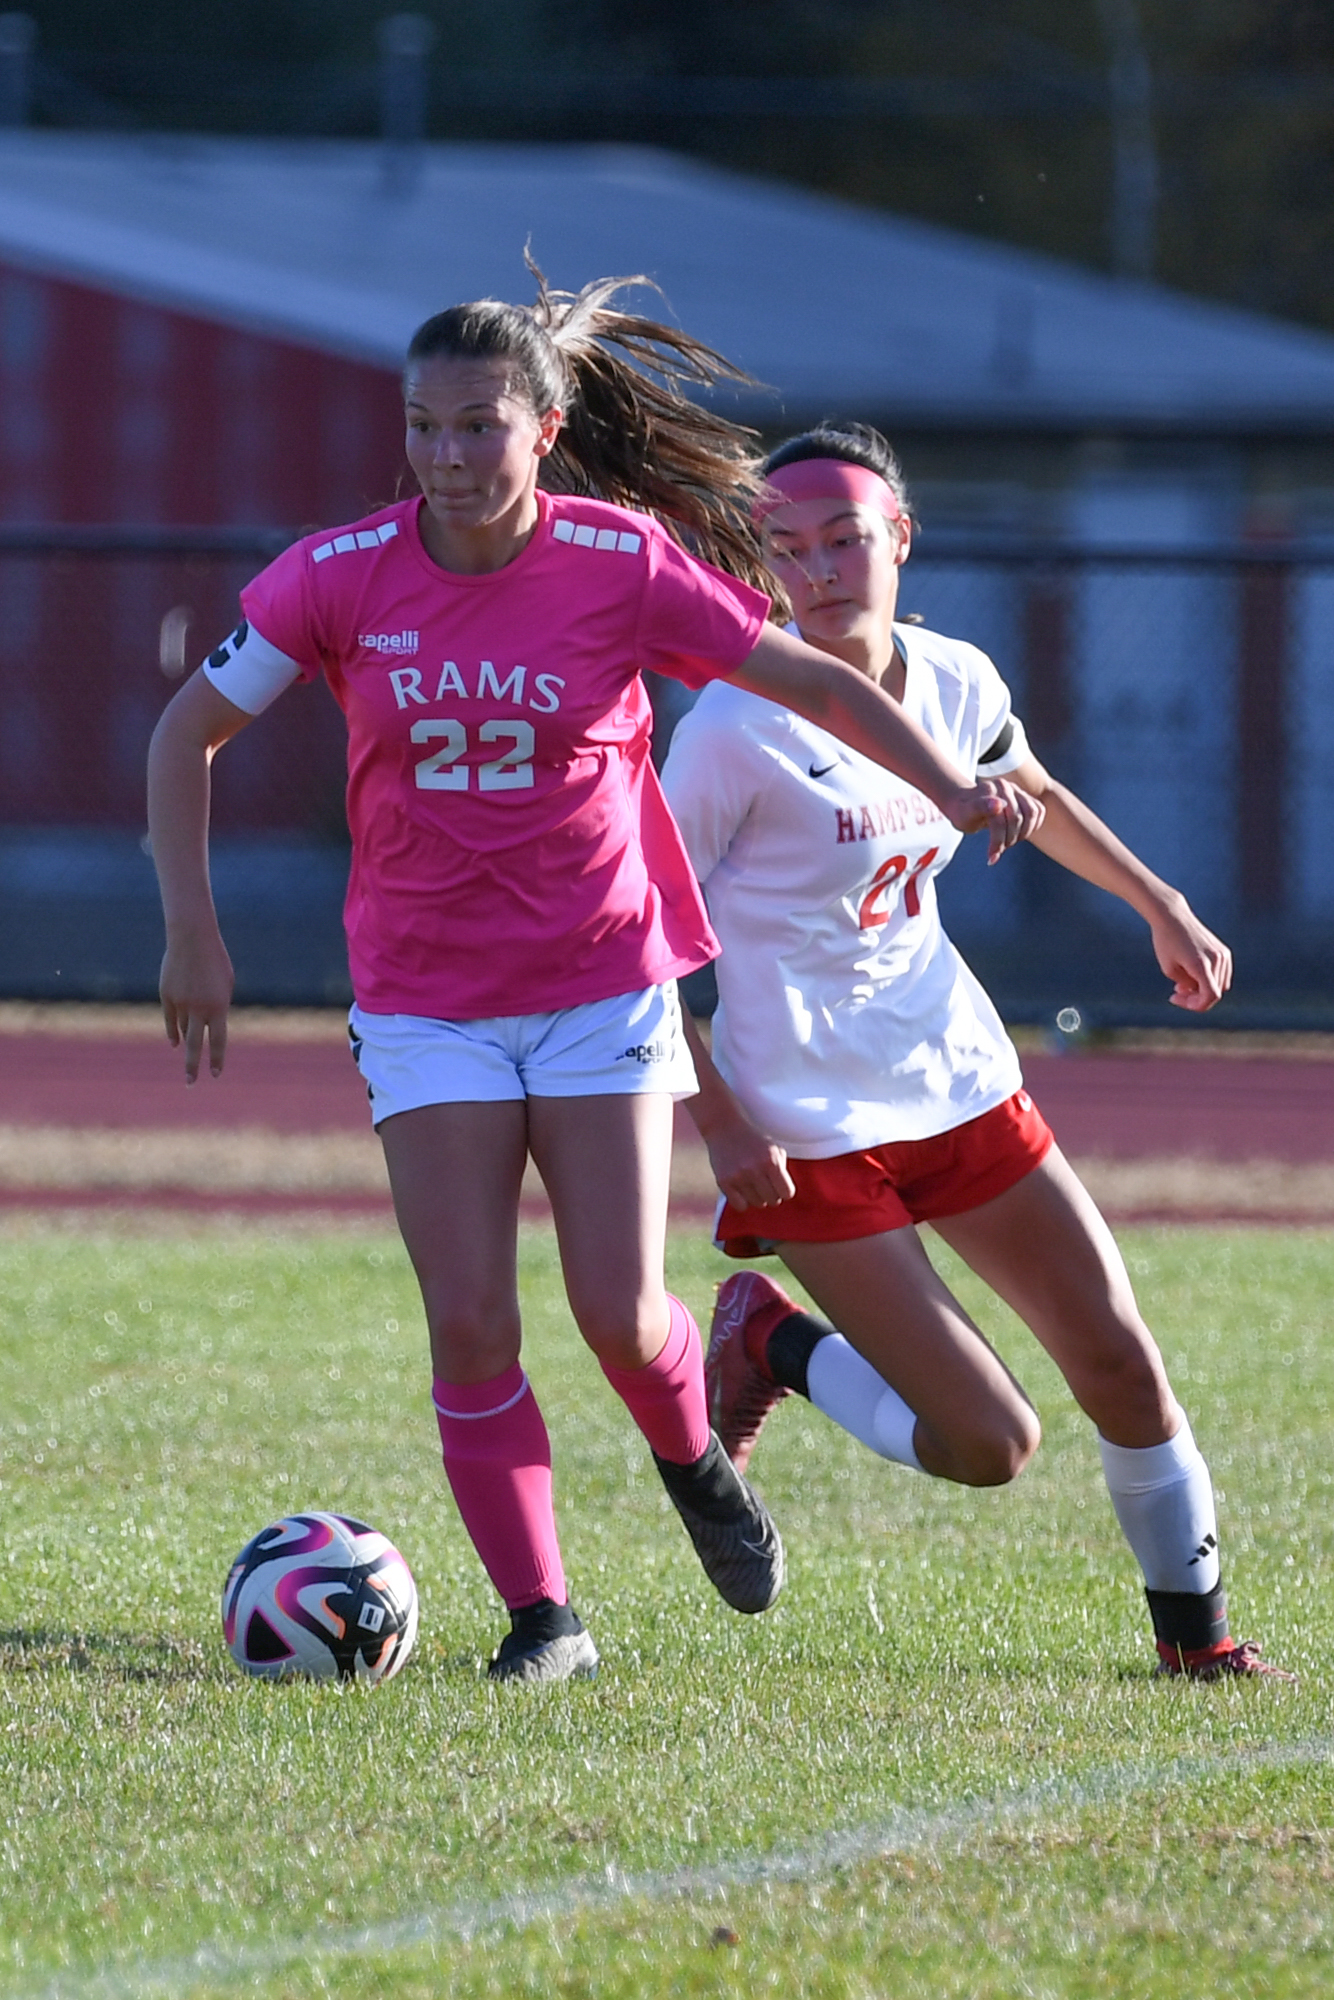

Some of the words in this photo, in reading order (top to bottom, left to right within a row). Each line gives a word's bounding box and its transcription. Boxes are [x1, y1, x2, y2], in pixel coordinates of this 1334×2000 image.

[388, 660, 566, 714] RAMS
[410, 719, 535, 791] 22
[859, 846, 940, 930] 21
[615, 1040, 665, 1062] apell
